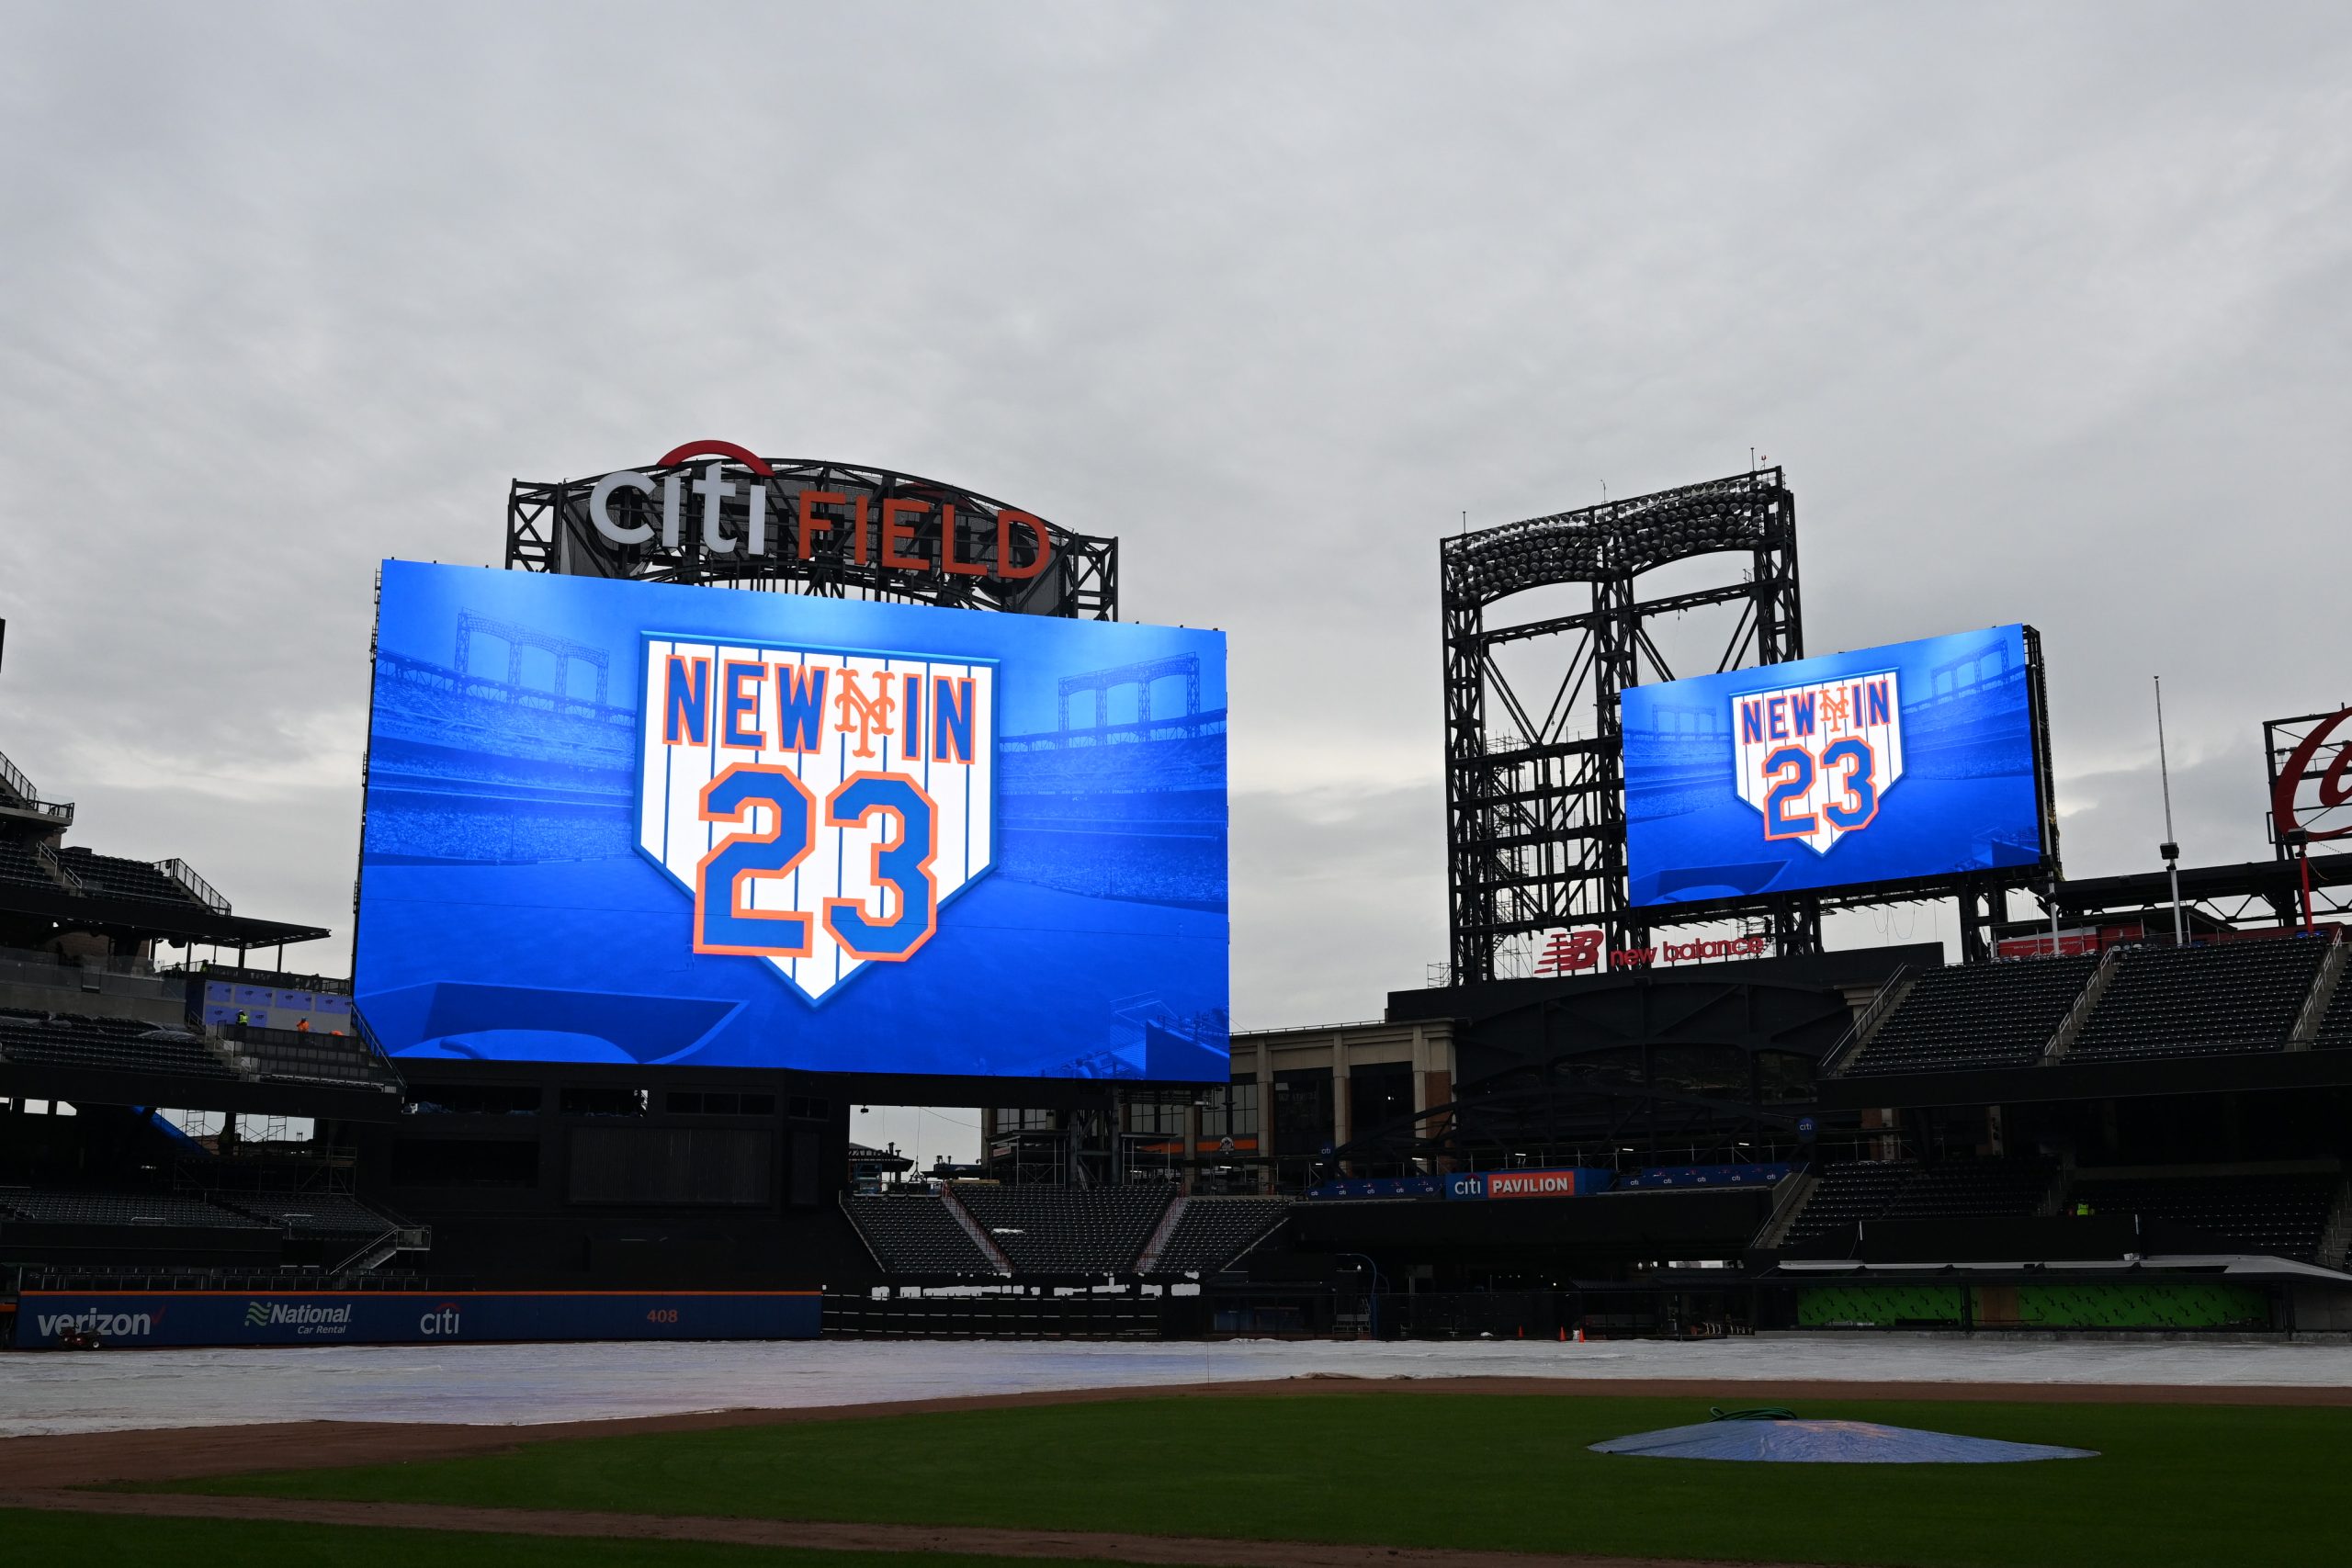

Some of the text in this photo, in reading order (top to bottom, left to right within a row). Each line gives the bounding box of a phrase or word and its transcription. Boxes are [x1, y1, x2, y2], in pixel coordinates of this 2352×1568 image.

[589, 461, 1051, 580] citi FIELD
[662, 654, 830, 754] NEW
[901, 672, 976, 765] IN
[1740, 691, 1816, 746] NEW
[1851, 679, 1891, 728] IN
[1761, 735, 1879, 841] 23
[693, 761, 938, 963] 23
[1610, 935, 1764, 967] new balance
[1799, 1122, 1812, 1131] citi
[1453, 1176, 1569, 1195] citi PAVILION
[37, 1308, 151, 1337] verizon
[269, 1303, 352, 1325] National
[420, 1308, 460, 1335] citi
[647, 1309, 678, 1324] 408
[297, 1324, 345, 1336] Car Rental
